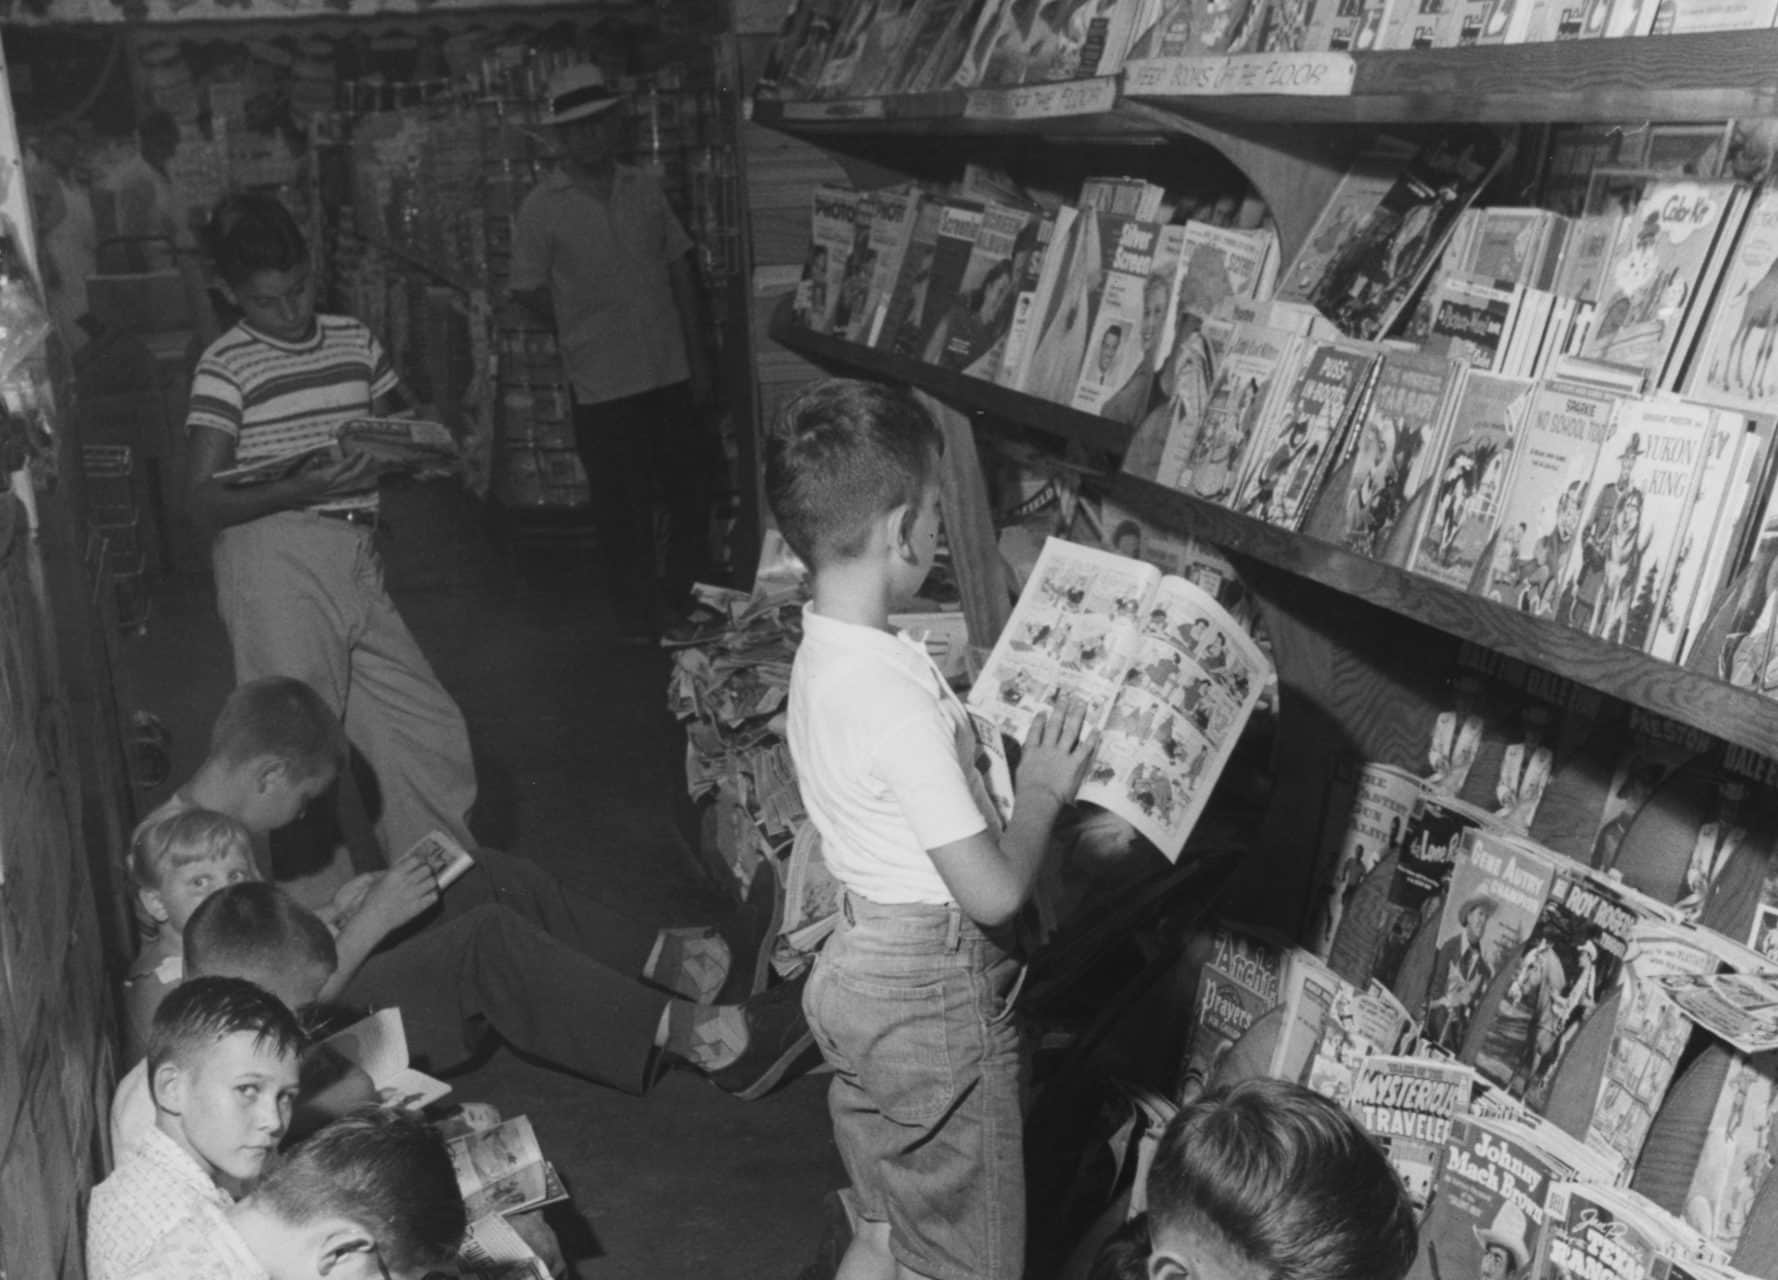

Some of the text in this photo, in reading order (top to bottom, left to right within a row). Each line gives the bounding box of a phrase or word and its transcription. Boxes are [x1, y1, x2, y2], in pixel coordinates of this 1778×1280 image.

[1551, 413, 1585, 440] SCHOOL
[1645, 433, 1699, 466] YUKON
[1650, 468, 1690, 500] KING
[1502, 856, 1546, 896] AUTRY
[1565, 886, 1601, 918] ROY
[1200, 978, 1253, 1030] Prayers
[1356, 1068, 1457, 1115] MYSTERIOU
[1474, 1131, 1543, 1193] Johnny
[1446, 1145, 1499, 1193] Mack
[1499, 1171, 1544, 1226] Brown
